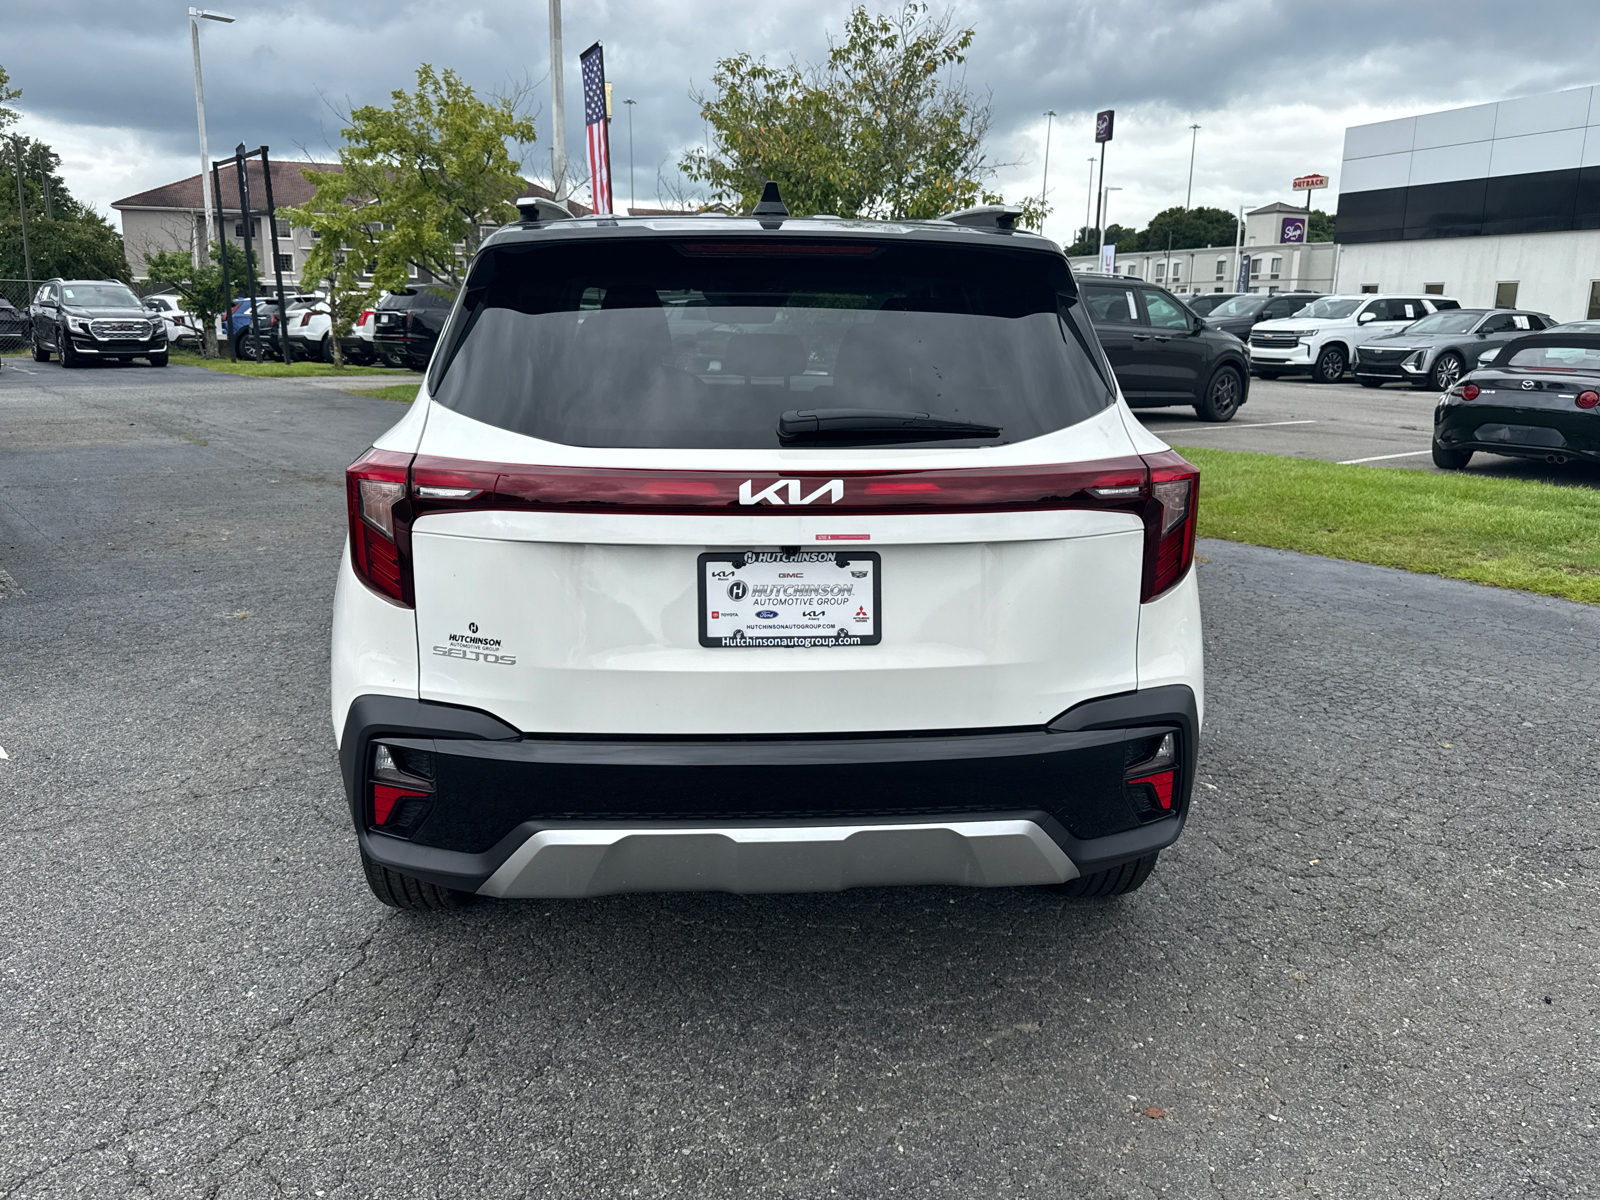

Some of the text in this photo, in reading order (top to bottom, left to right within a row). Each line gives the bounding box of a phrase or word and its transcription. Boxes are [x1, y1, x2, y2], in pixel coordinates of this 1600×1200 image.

[1292, 179, 1324, 188] OUTBACK
[738, 479, 844, 505] KIA
[758, 552, 837, 563] HUTCHINSON
[751, 584, 853, 598] HUTCHINSON
[753, 598, 849, 606] AUTOMOTIVE GROUP
[759, 610, 775, 619] Ford
[448, 633, 502, 647] HUTCHINSON
[721, 637, 861, 648] Hutchinsonautogroup.com
[449, 641, 481, 651] AUTOMOTIVE
[432, 645, 517, 666] SELTOS
